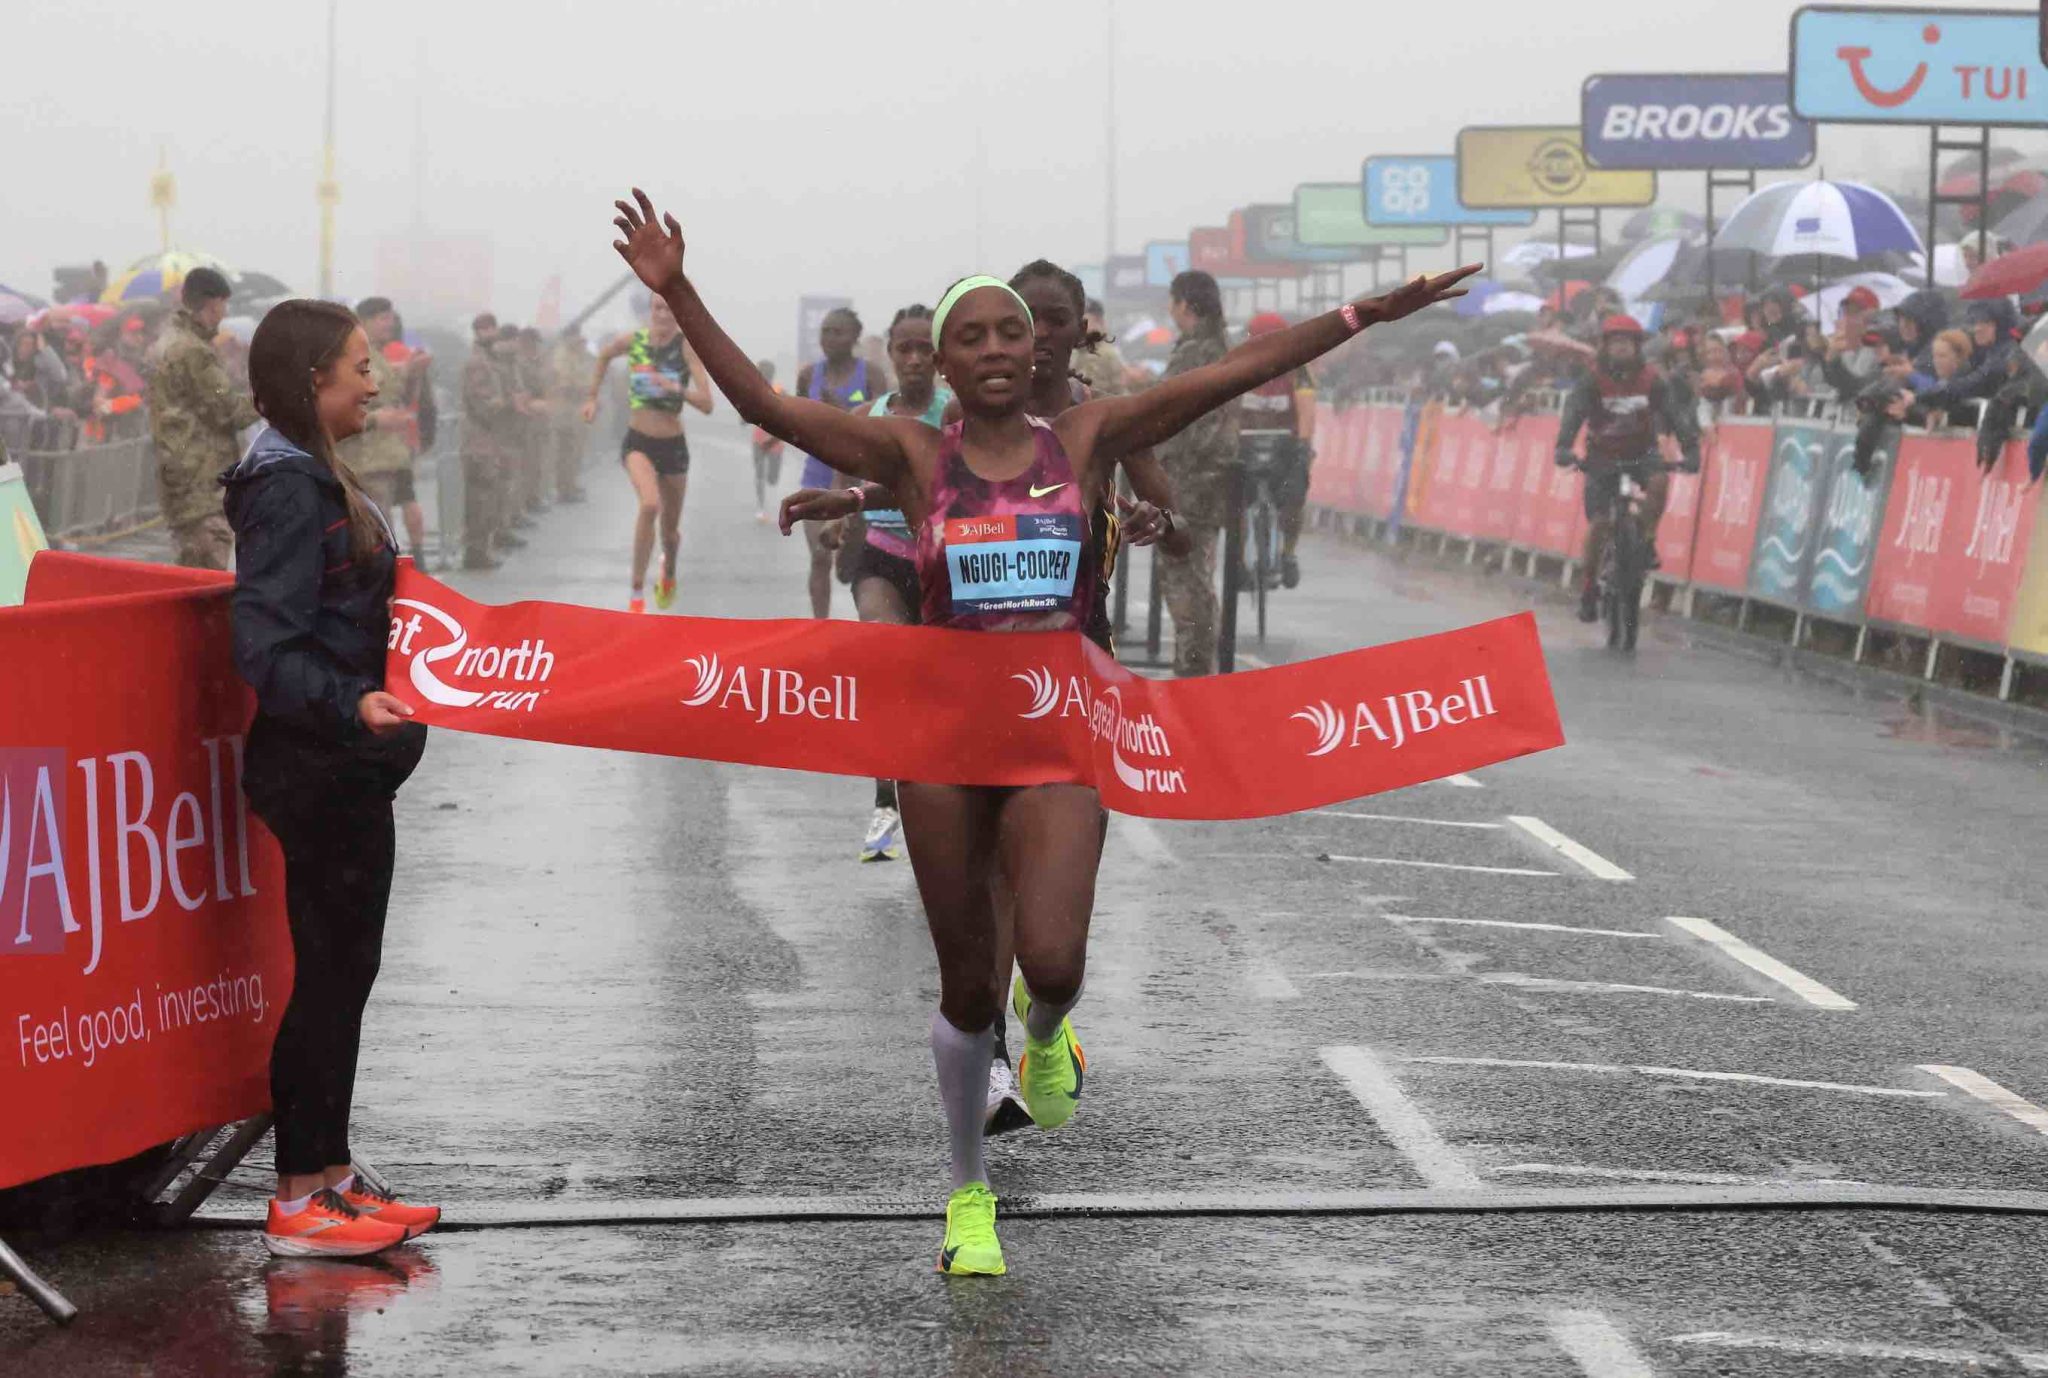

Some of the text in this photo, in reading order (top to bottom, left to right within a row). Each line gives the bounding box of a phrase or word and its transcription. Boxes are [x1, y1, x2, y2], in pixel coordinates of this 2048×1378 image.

[1954, 66, 2028, 101] TUI
[1602, 103, 1792, 141] BROOKS
[970, 523, 1004, 536] AJBell
[959, 550, 1071, 584] NGUGI-COOPER
[455, 638, 554, 682] north
[473, 689, 540, 713] run
[719, 665, 860, 723] AJBell
[1350, 674, 1498, 749] AJBell
[1121, 714, 1171, 757] north
[1145, 767, 1187, 793] run
[14, 734, 258, 976] AJBell
[18, 968, 270, 1067] Feel good, investing.
